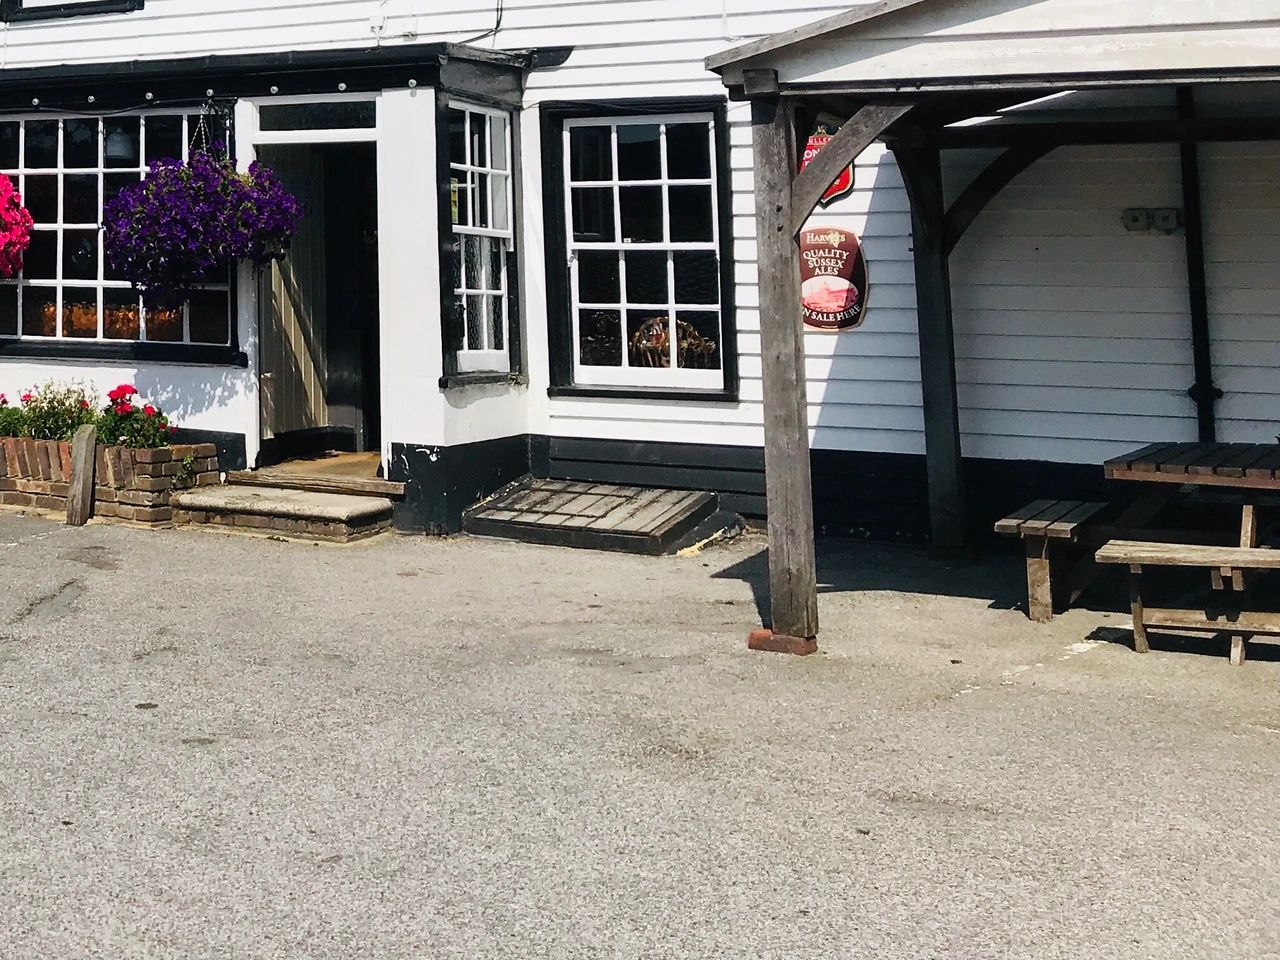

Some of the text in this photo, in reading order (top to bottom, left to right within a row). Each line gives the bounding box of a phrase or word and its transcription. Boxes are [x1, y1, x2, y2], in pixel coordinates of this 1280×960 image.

[803, 248, 850, 259] QUALITY
[808, 257, 845, 268] SUSSEX
[814, 266, 839, 275] ALES
[801, 304, 862, 322] N SALE HERE
